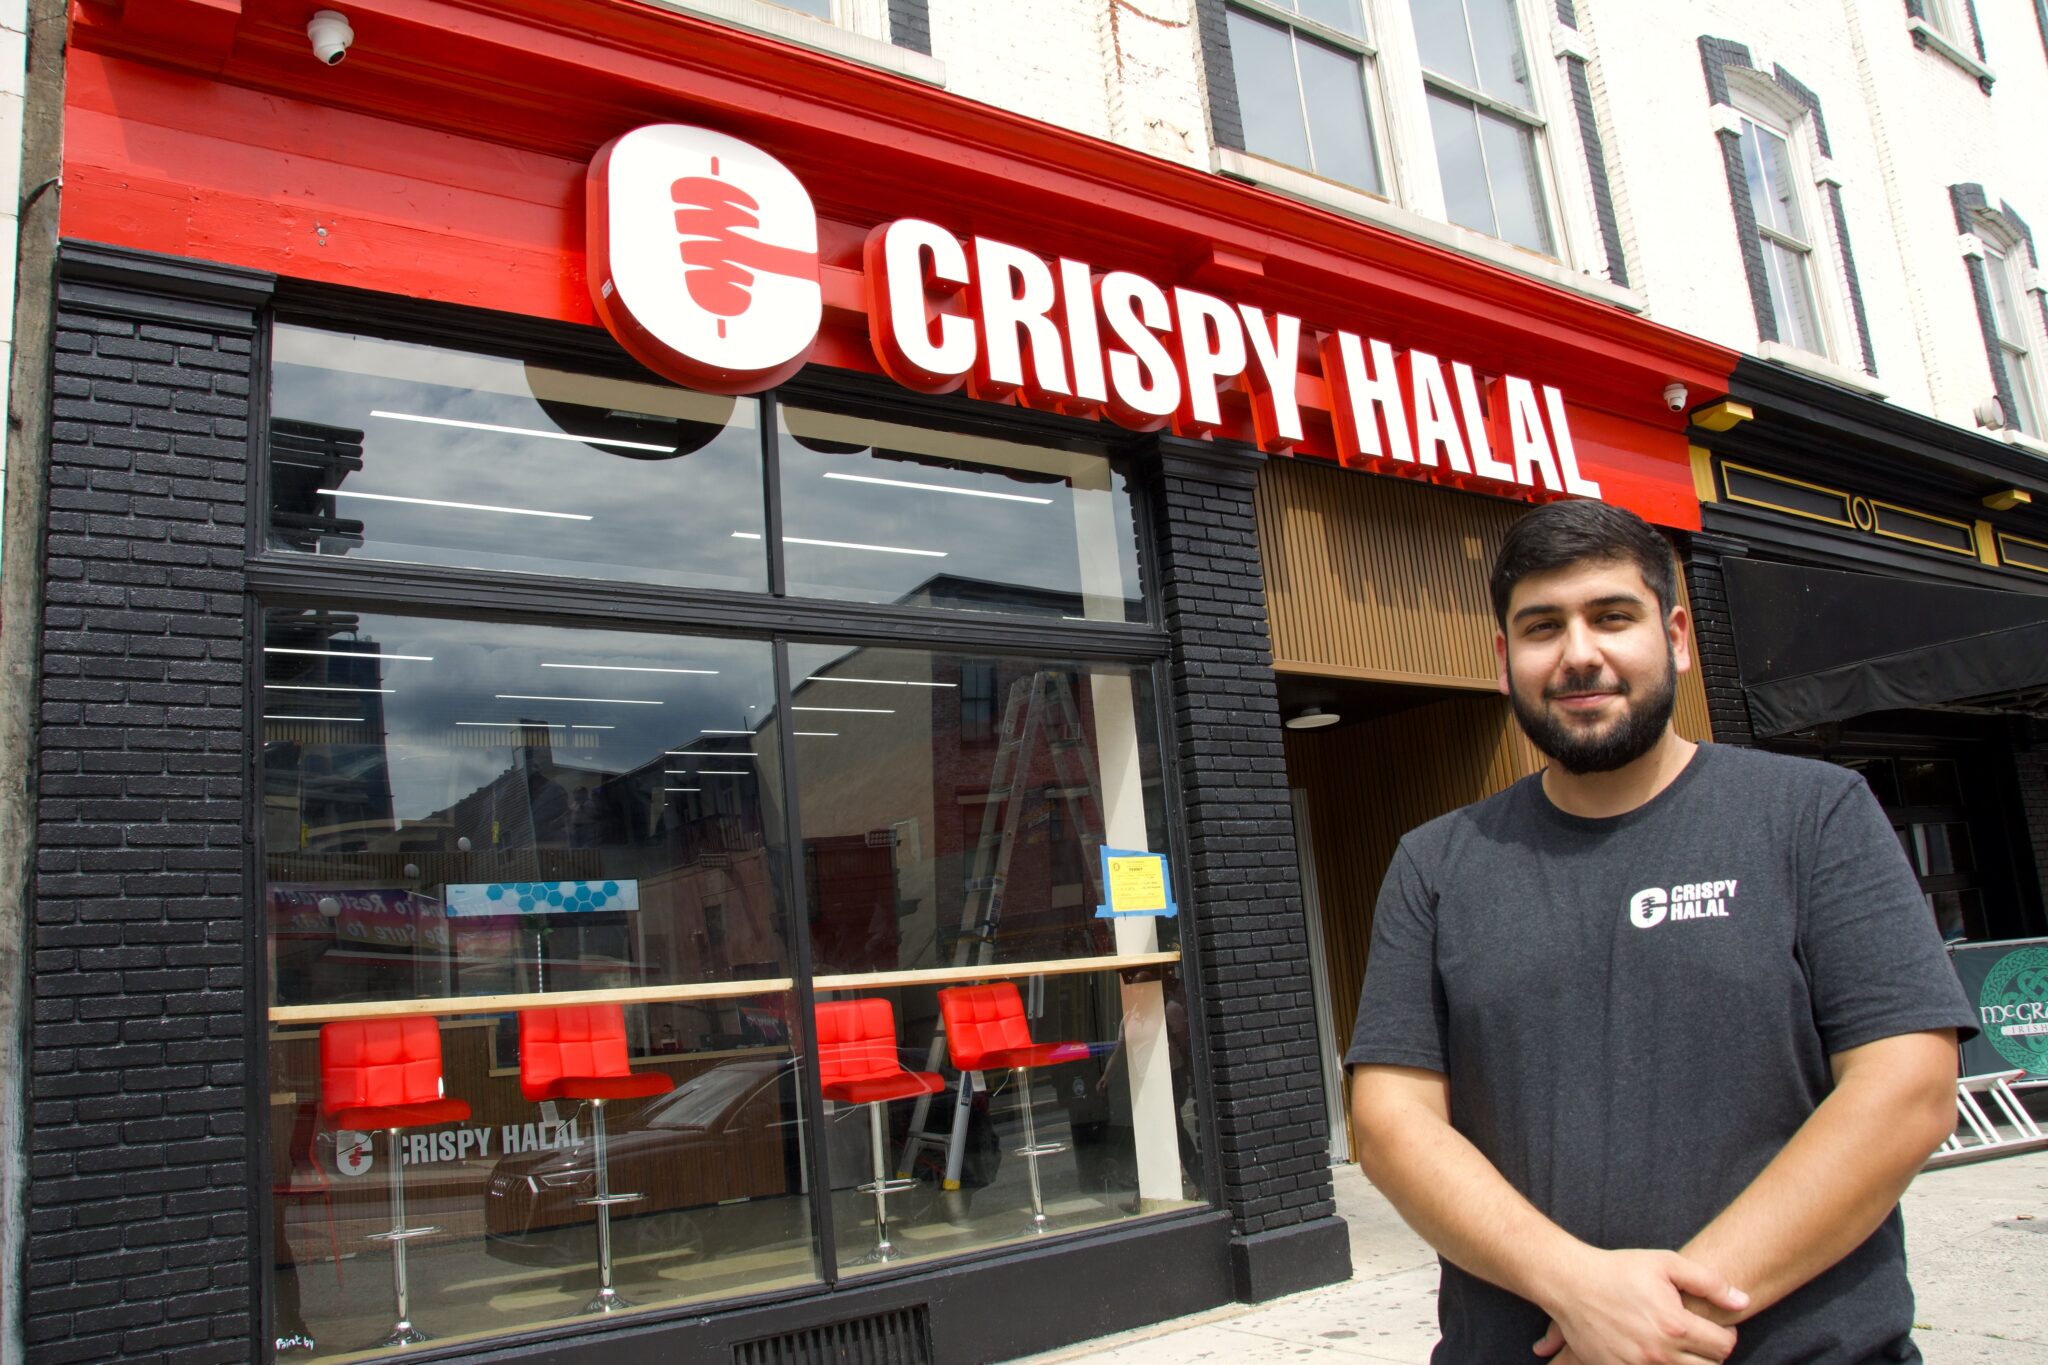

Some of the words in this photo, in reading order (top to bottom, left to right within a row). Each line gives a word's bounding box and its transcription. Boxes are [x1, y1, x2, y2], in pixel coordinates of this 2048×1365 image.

[885, 217, 1304, 443] CRISPY
[1338, 330, 1602, 500] HALAL
[1671, 879, 1738, 903] CRISPY
[1670, 898, 1730, 921] HALAL
[502, 1118, 585, 1155] HALAL
[303, 1336, 314, 1351] by
